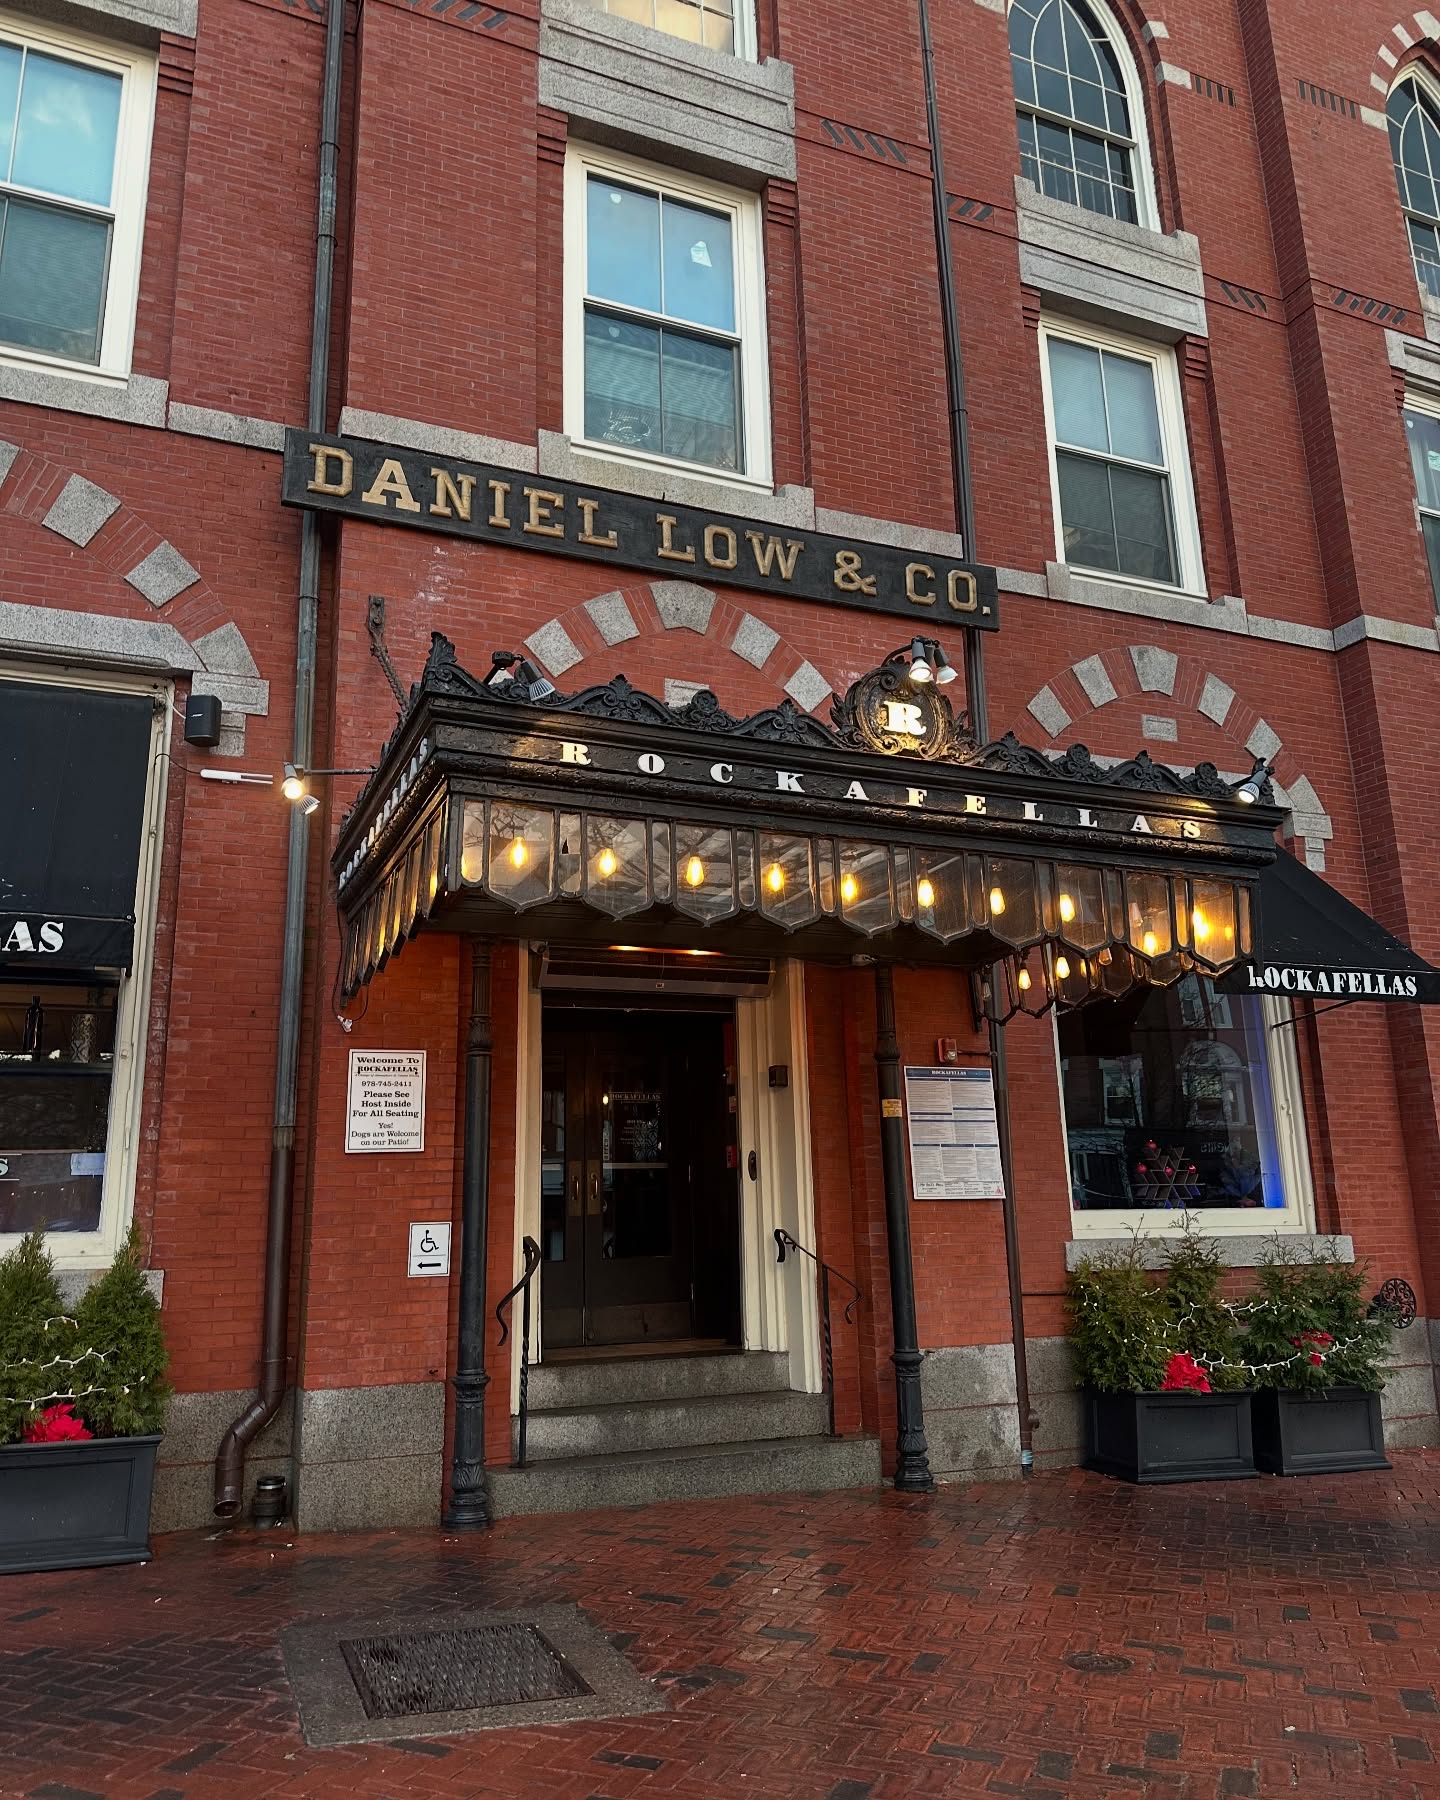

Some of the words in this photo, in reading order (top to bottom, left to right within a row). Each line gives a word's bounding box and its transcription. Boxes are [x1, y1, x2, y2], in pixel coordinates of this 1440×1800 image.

[307, 443, 618, 549] DANIEL
[656, 513, 805, 581] LOW
[833, 550, 877, 596] &
[905, 562, 991, 616] CO.
[883, 700, 927, 736] R
[559, 742, 1201, 839] ROCKAFELLAS
[0, 921, 64, 952] AS
[357, 1065, 418, 1075] ROCKAFELLAS
[385, 1109, 419, 1118] Seating
[351, 1130, 371, 1138] Dogs
[388, 1138, 409, 1146] Patio!
